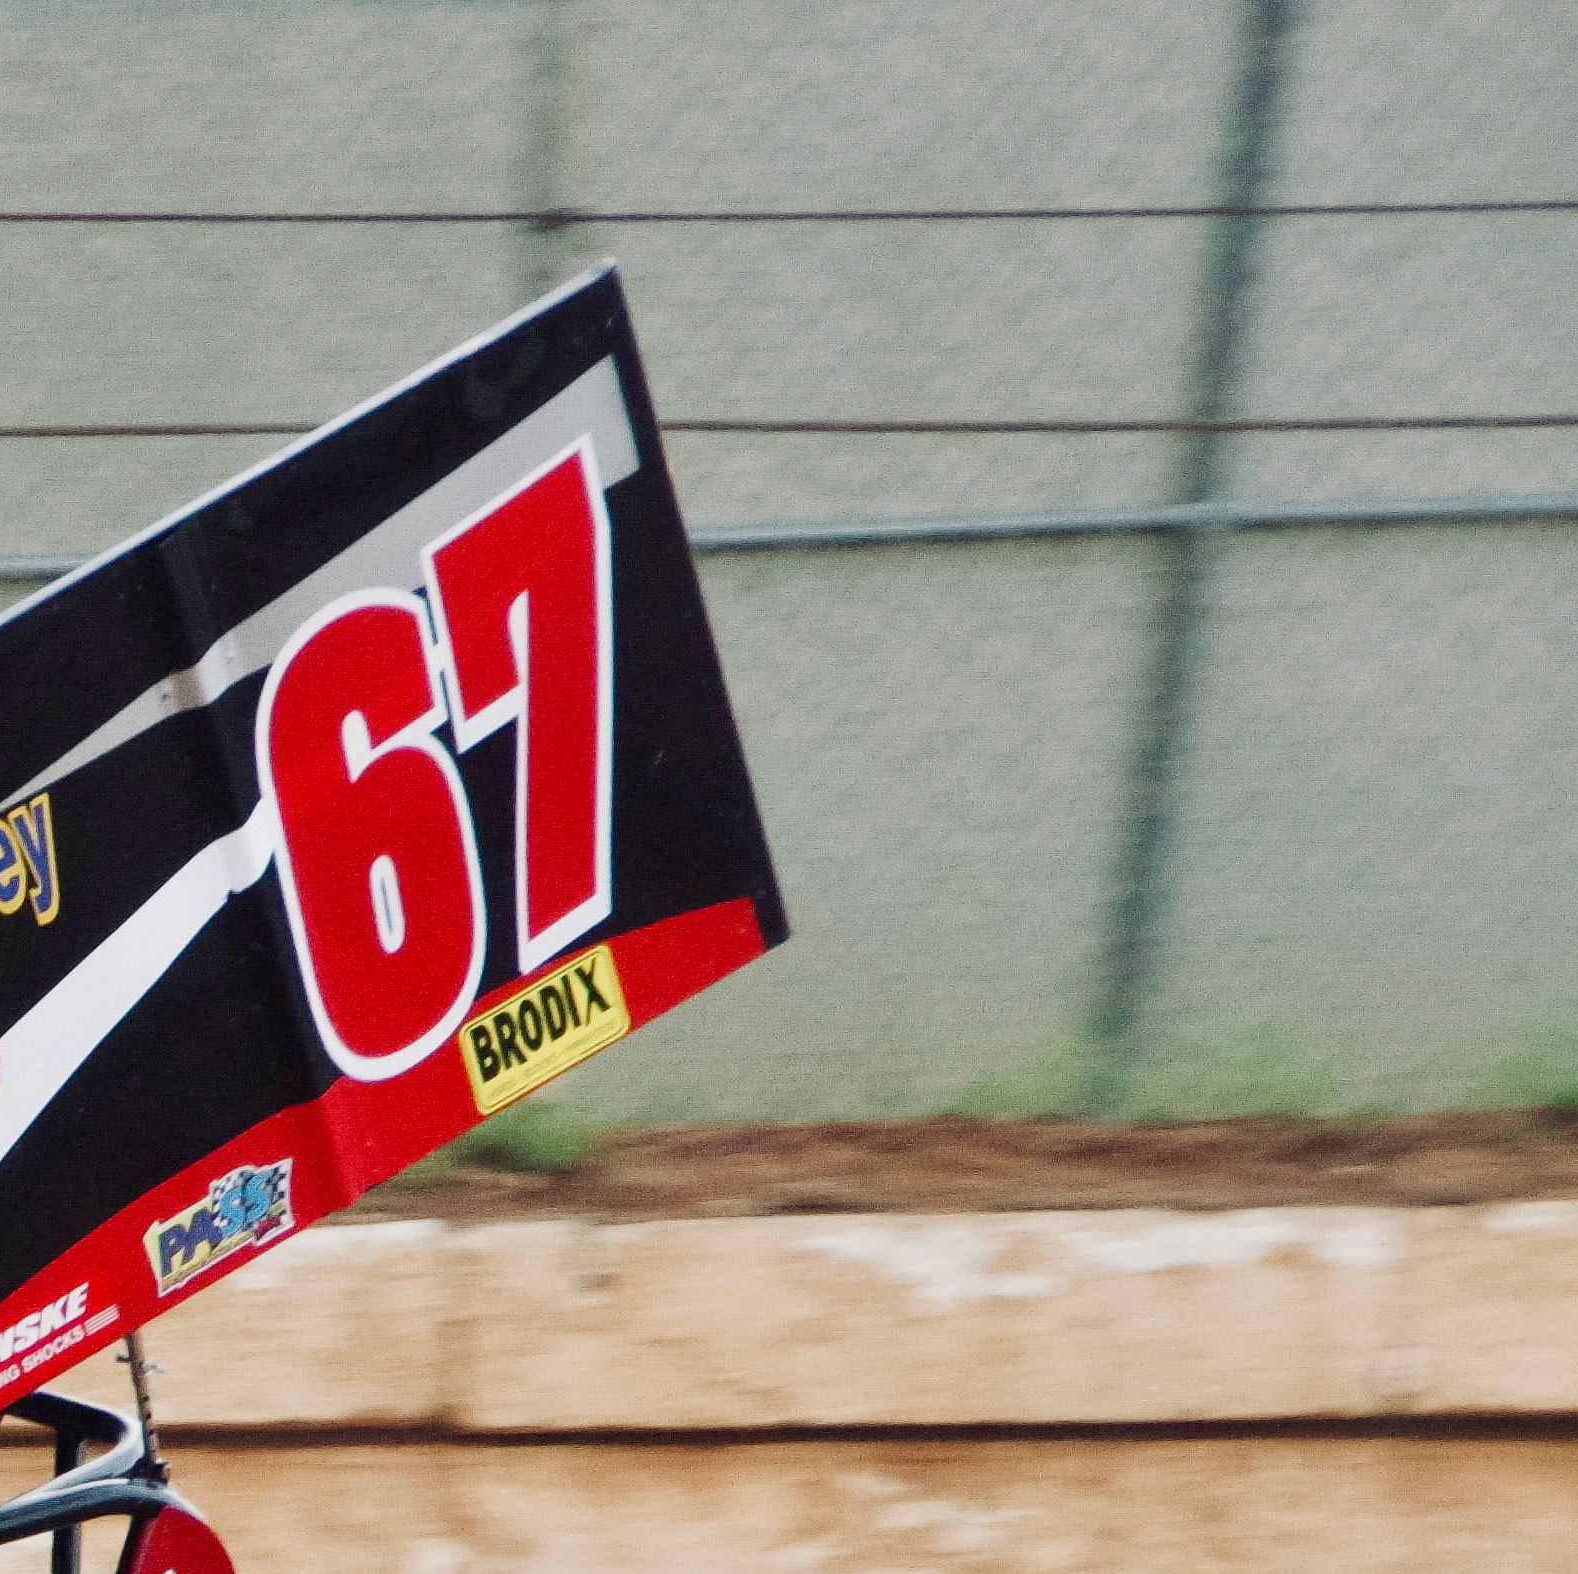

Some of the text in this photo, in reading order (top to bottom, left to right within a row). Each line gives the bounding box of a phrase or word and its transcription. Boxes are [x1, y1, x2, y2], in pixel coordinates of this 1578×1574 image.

[255, 432, 613, 1081] 67
[469, 957, 612, 1083] BRODIX
[20, 1325, 85, 1373] SHOCKS
